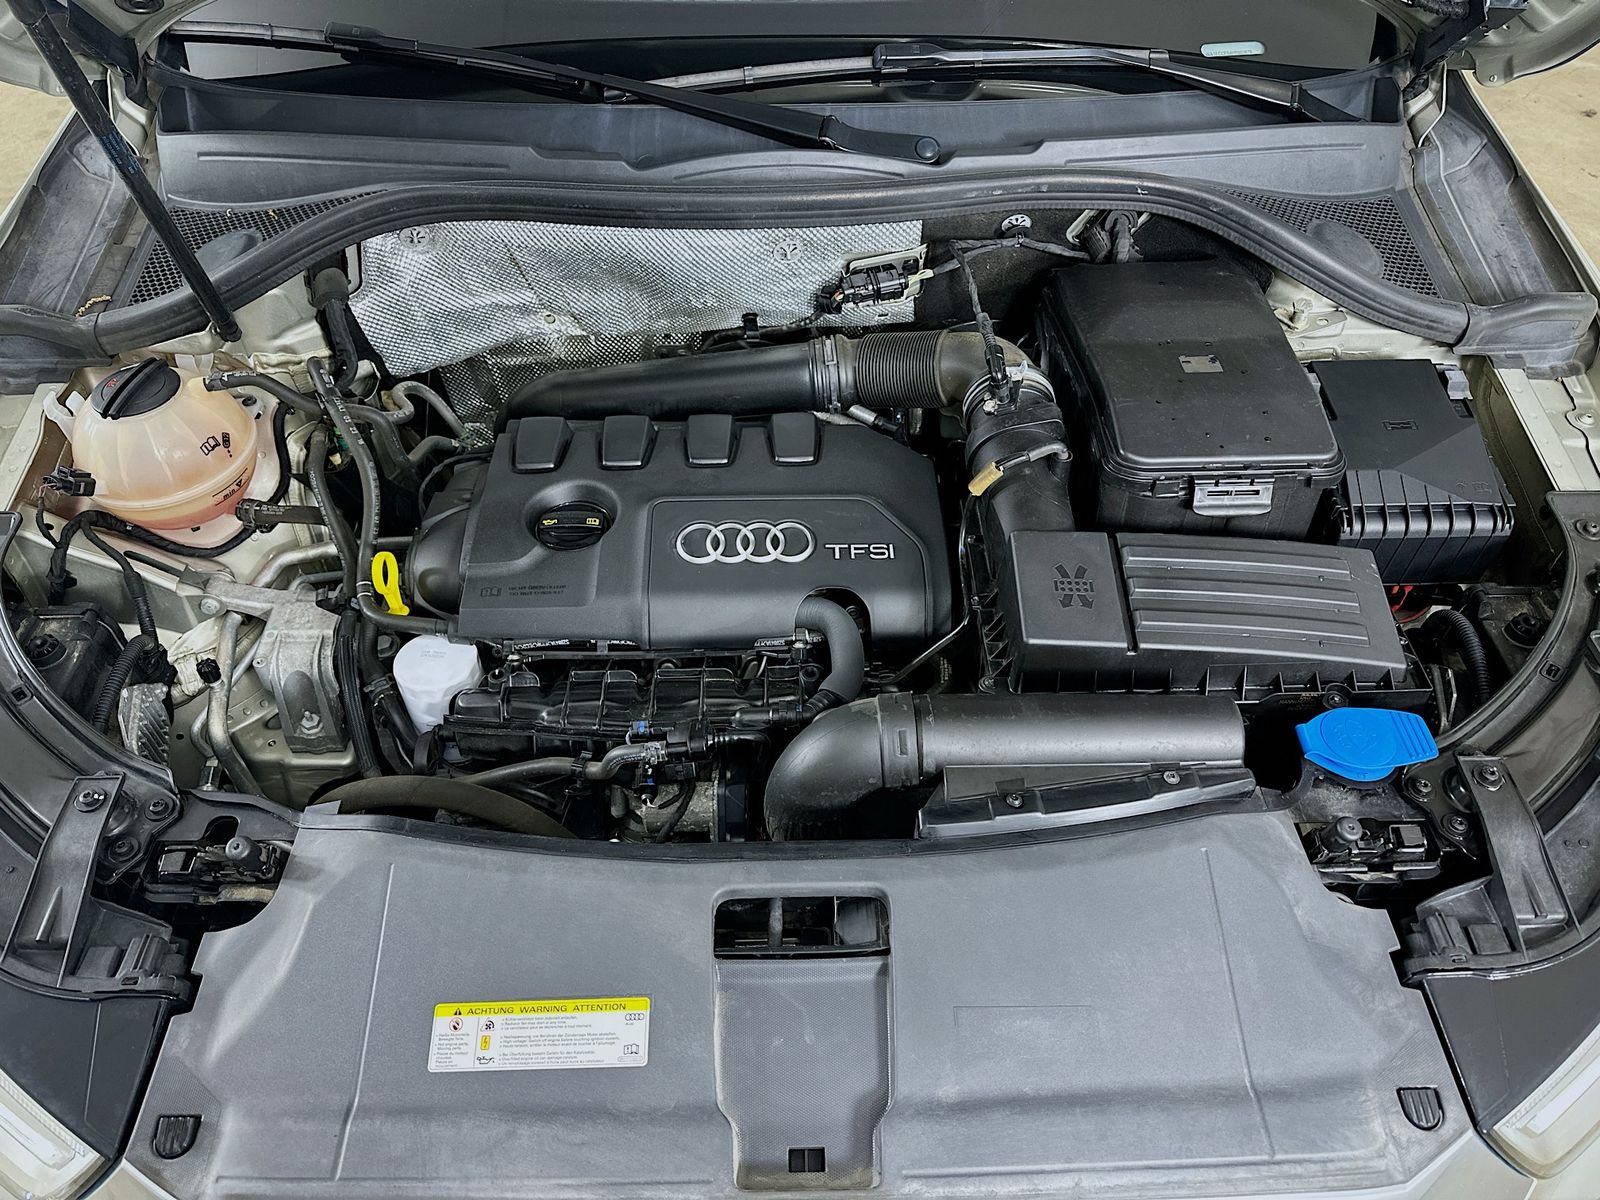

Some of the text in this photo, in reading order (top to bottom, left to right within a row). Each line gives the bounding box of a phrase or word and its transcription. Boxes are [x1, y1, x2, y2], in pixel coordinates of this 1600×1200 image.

[222, 488, 236, 500] min
[825, 543, 895, 559] TFSI
[467, 1002, 627, 1015] ACHTUNG WARNING ATTENTION
